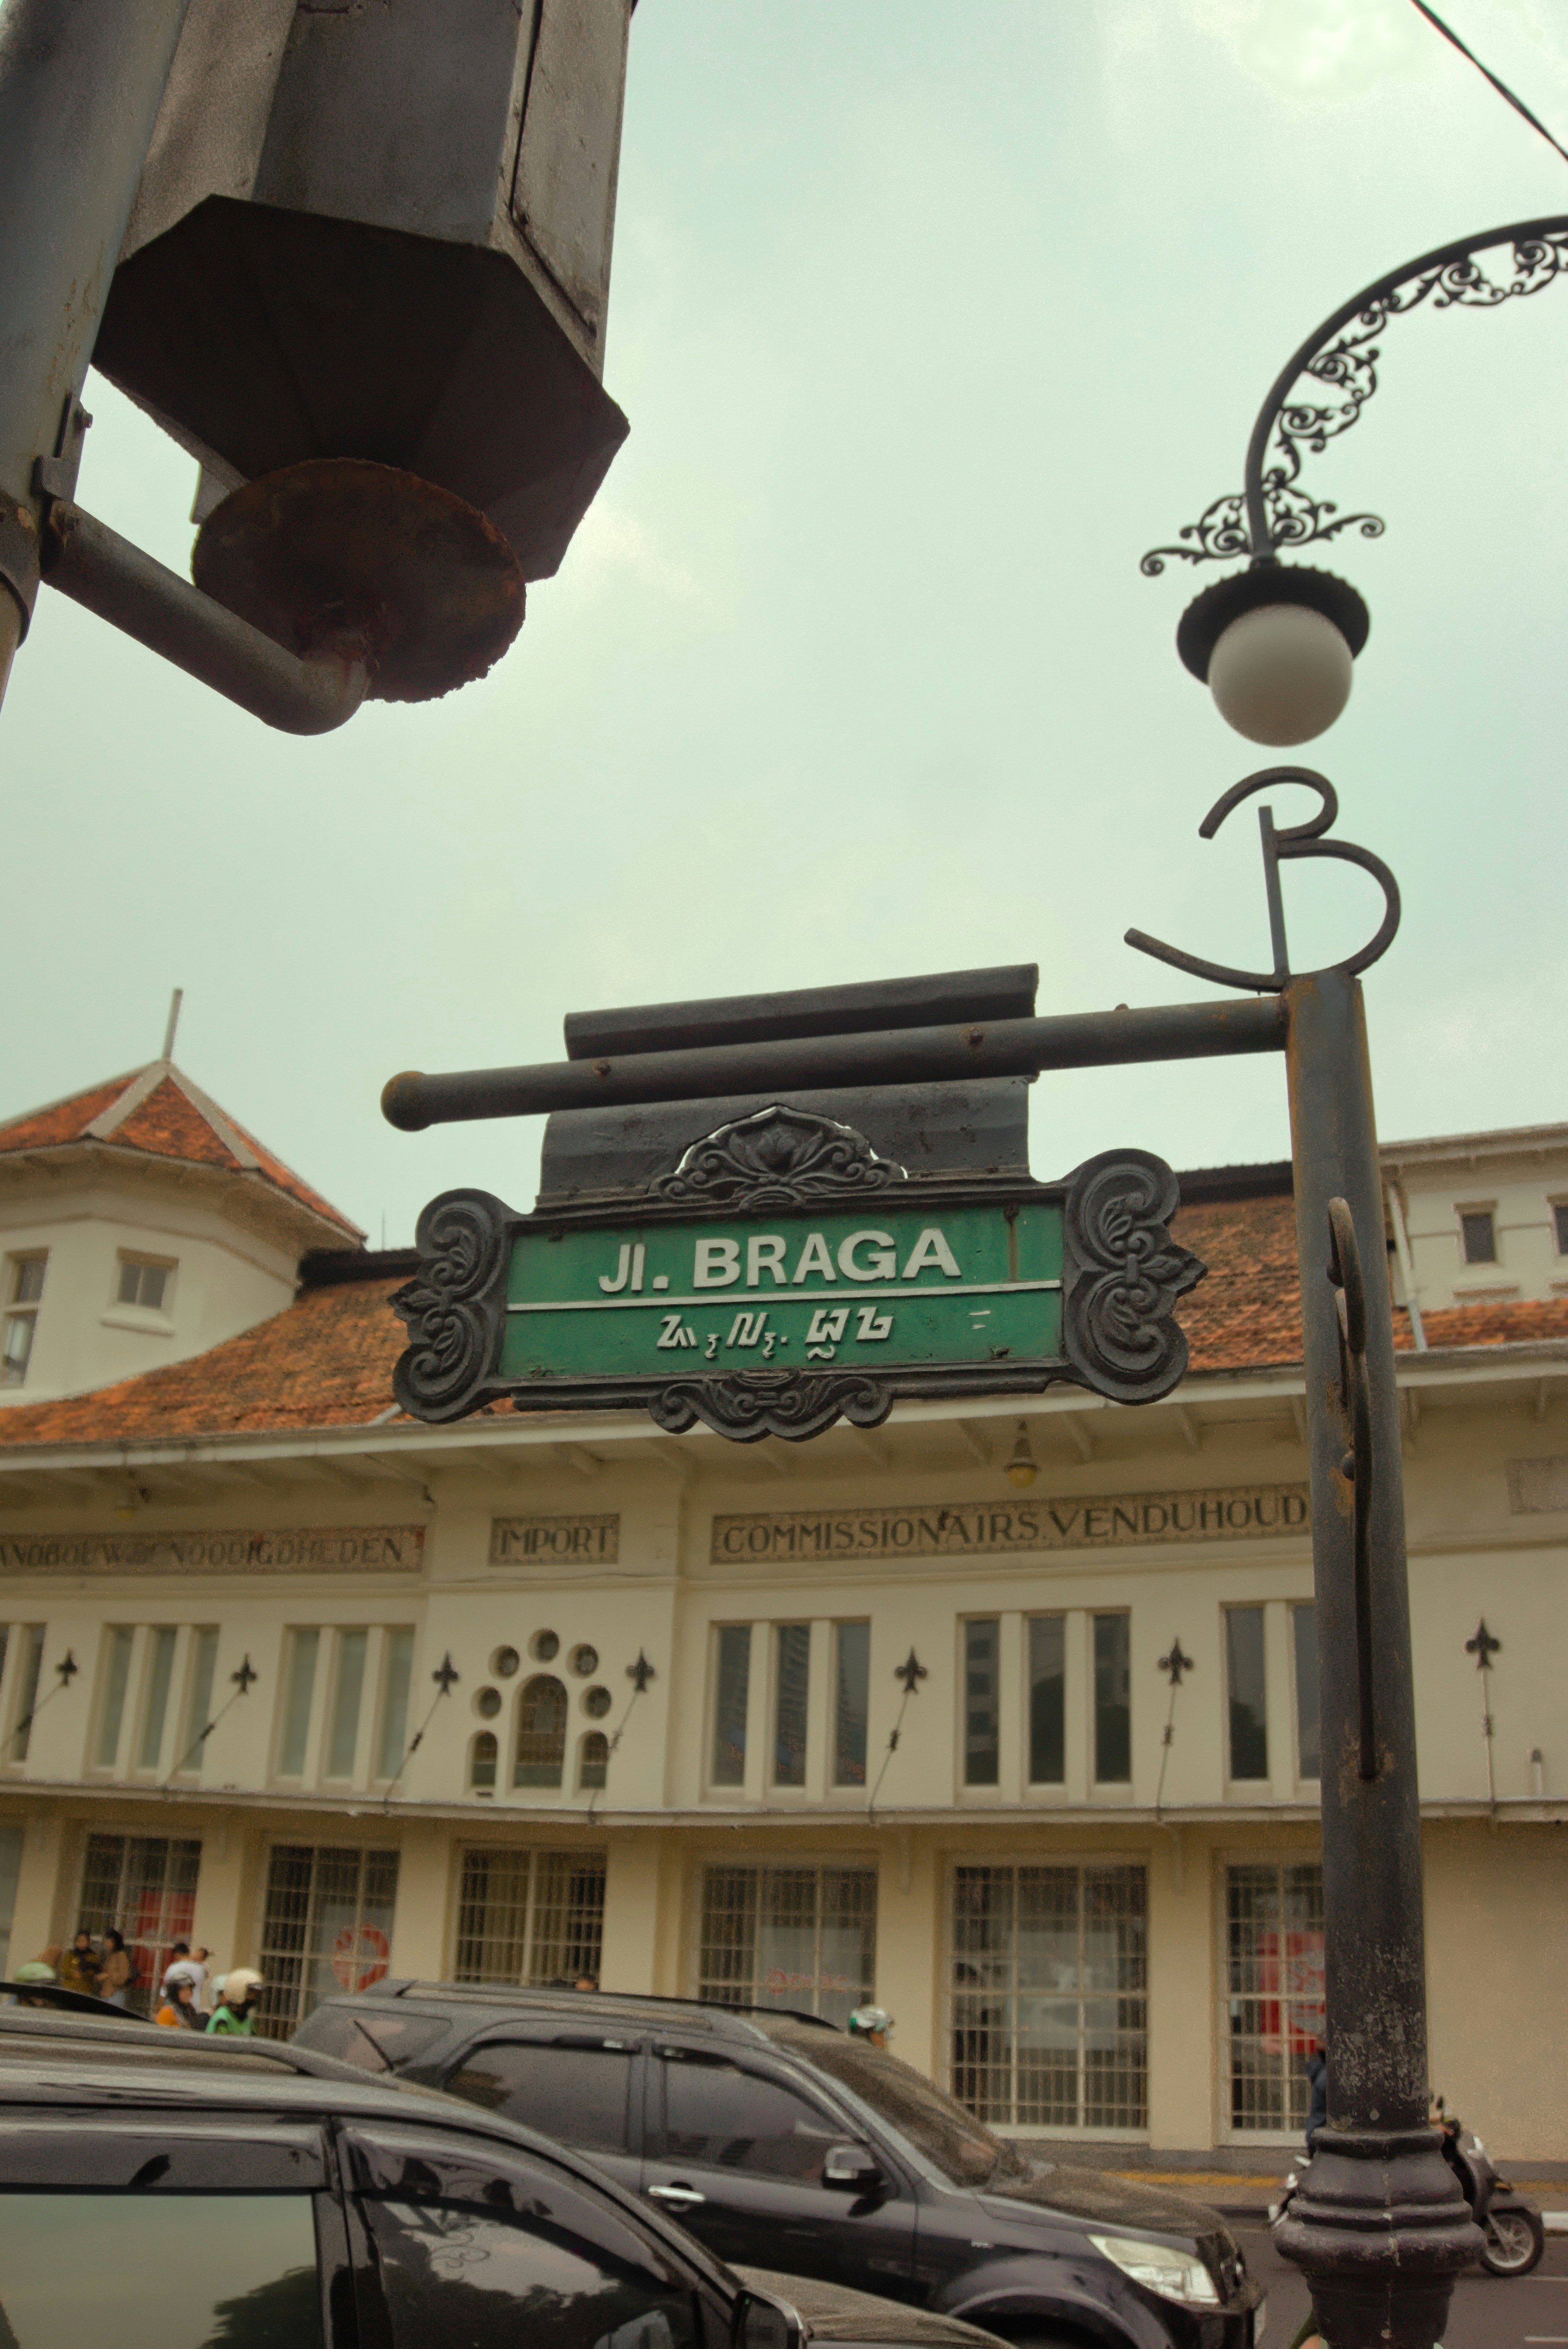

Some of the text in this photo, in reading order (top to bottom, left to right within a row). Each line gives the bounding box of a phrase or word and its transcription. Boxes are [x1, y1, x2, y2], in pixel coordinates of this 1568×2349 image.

[1124, 766, 1401, 993] B
[599, 1228, 963, 1292] Jl. BRAGA
[500, 1525, 615, 1556] IMPORT
